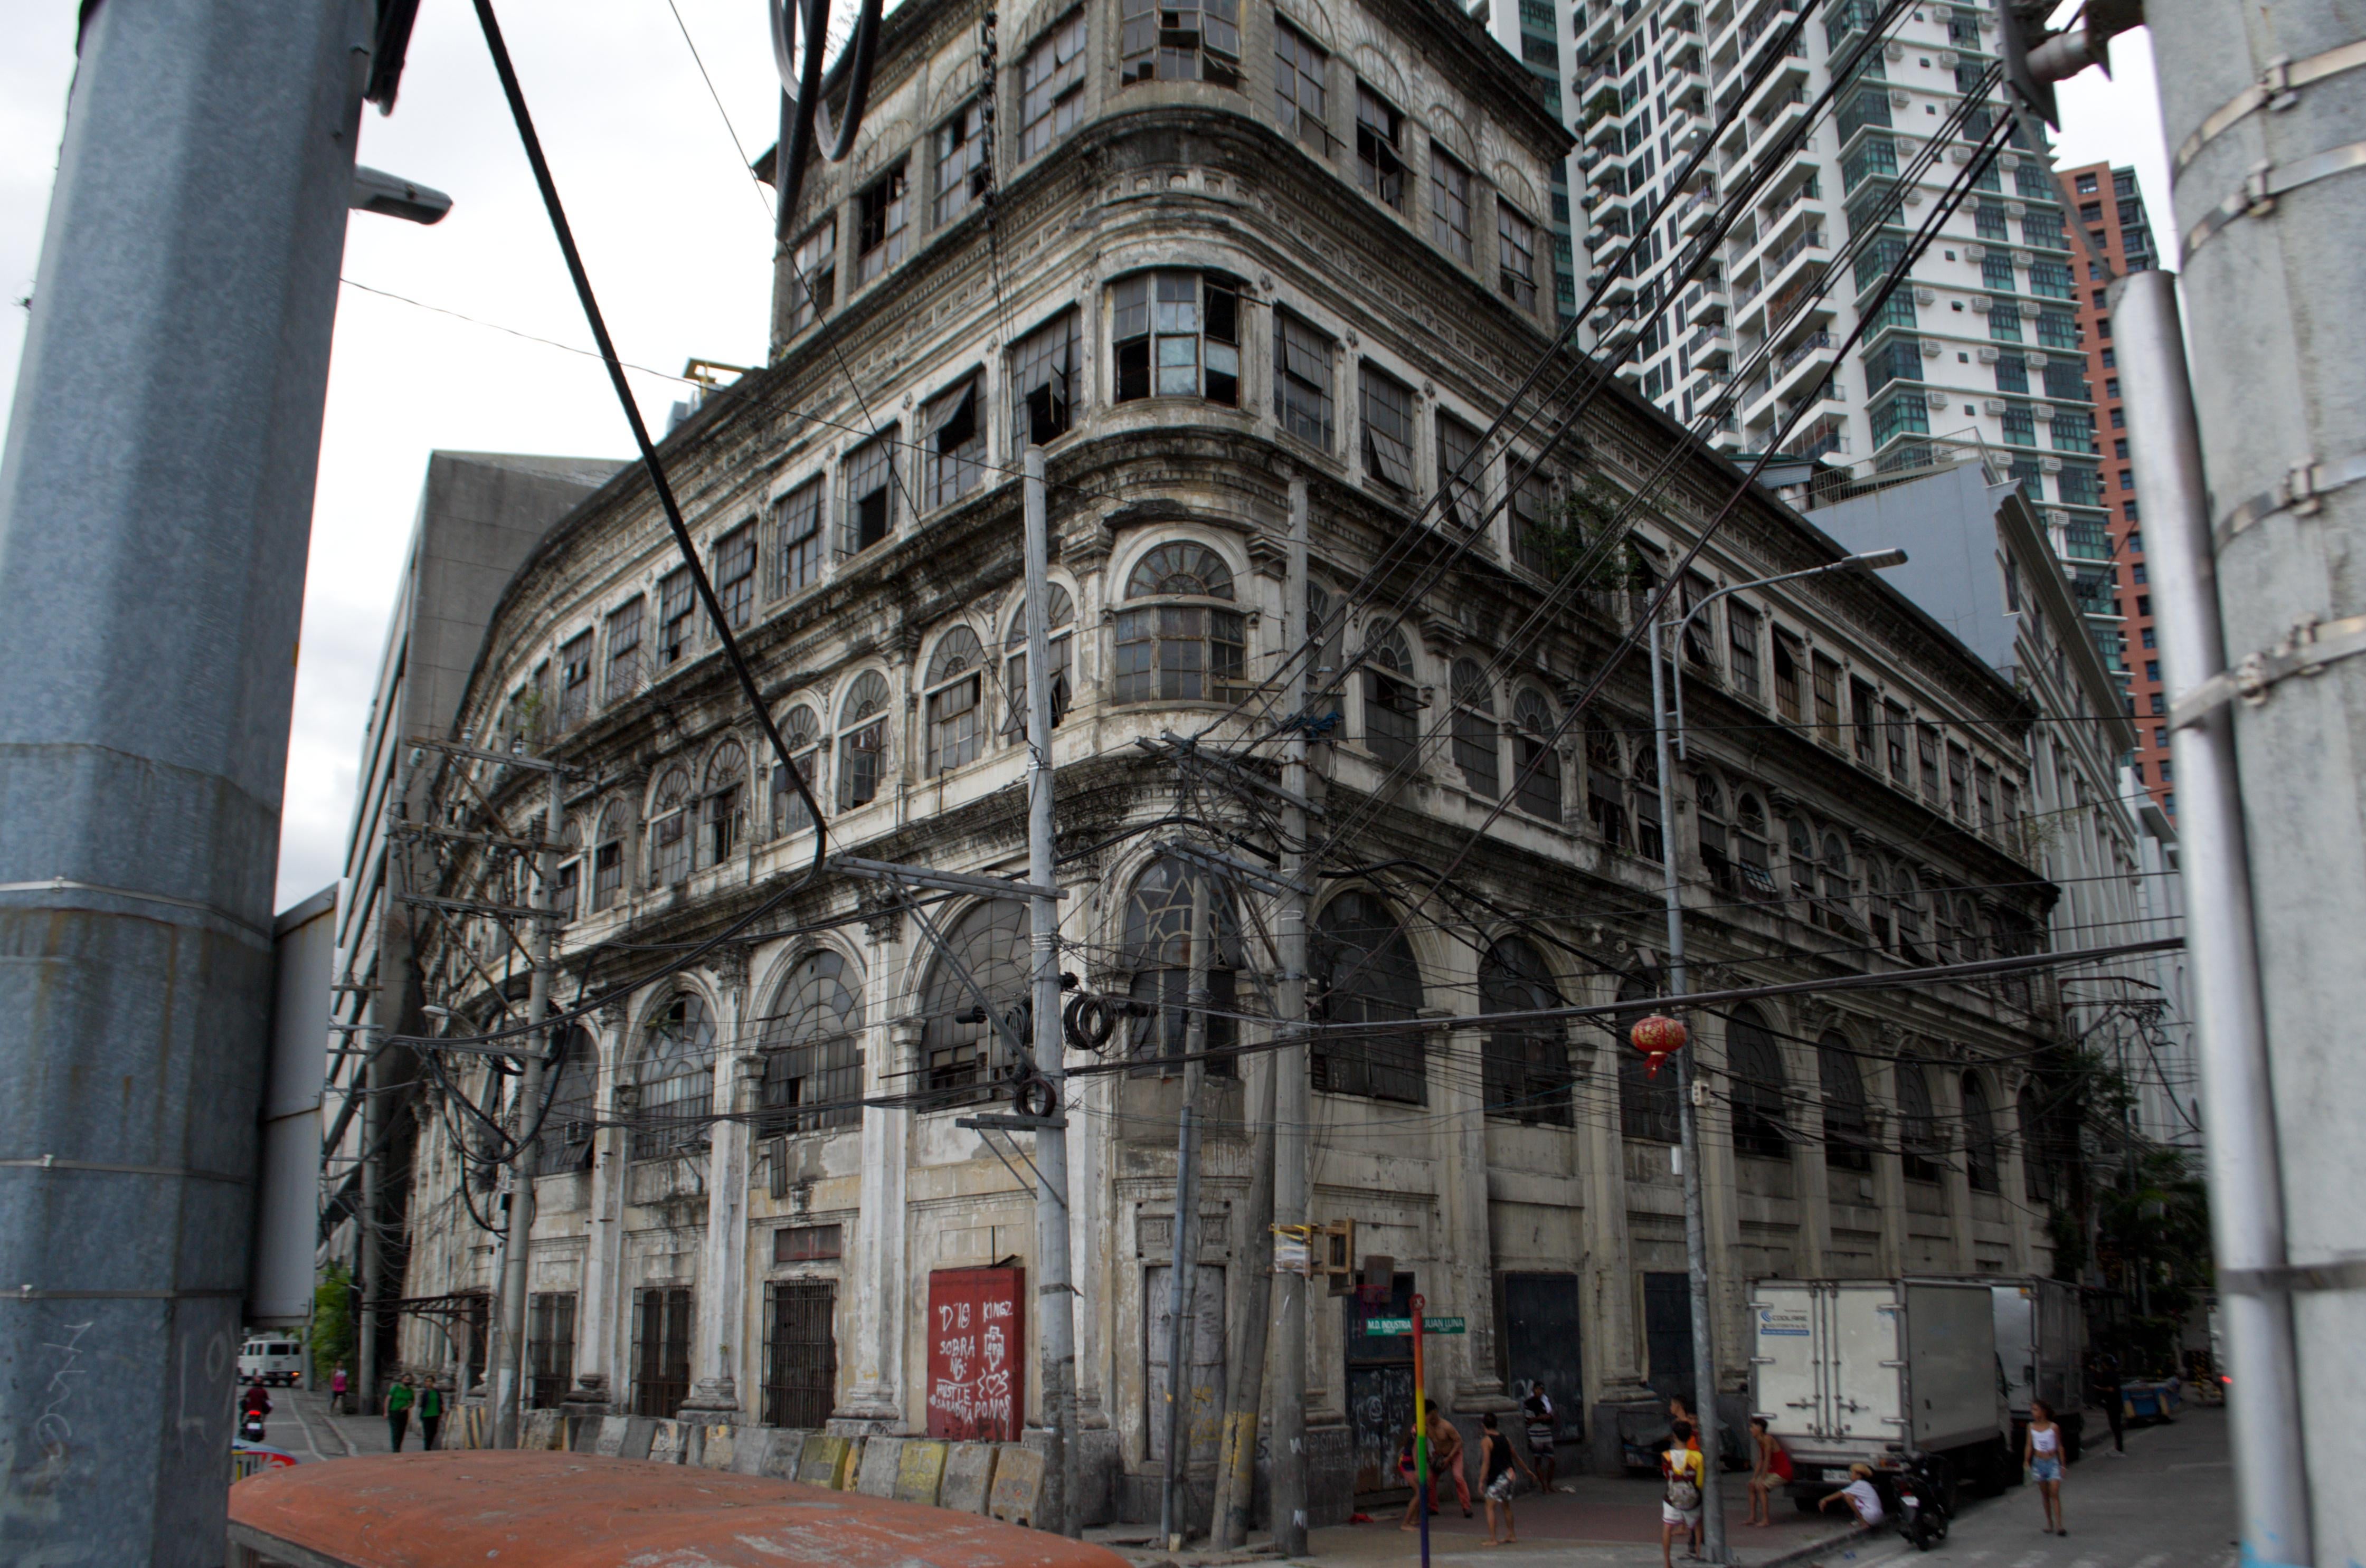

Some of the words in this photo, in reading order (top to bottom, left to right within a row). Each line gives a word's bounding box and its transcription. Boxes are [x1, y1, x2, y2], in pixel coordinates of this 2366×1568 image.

[1425, 1318, 1443, 1328] JUAN
[1444, 1318, 1464, 1327] LUNA
[939, 1335, 975, 1360] SOBRA
[936, 1384, 972, 1405] HUSTLE
